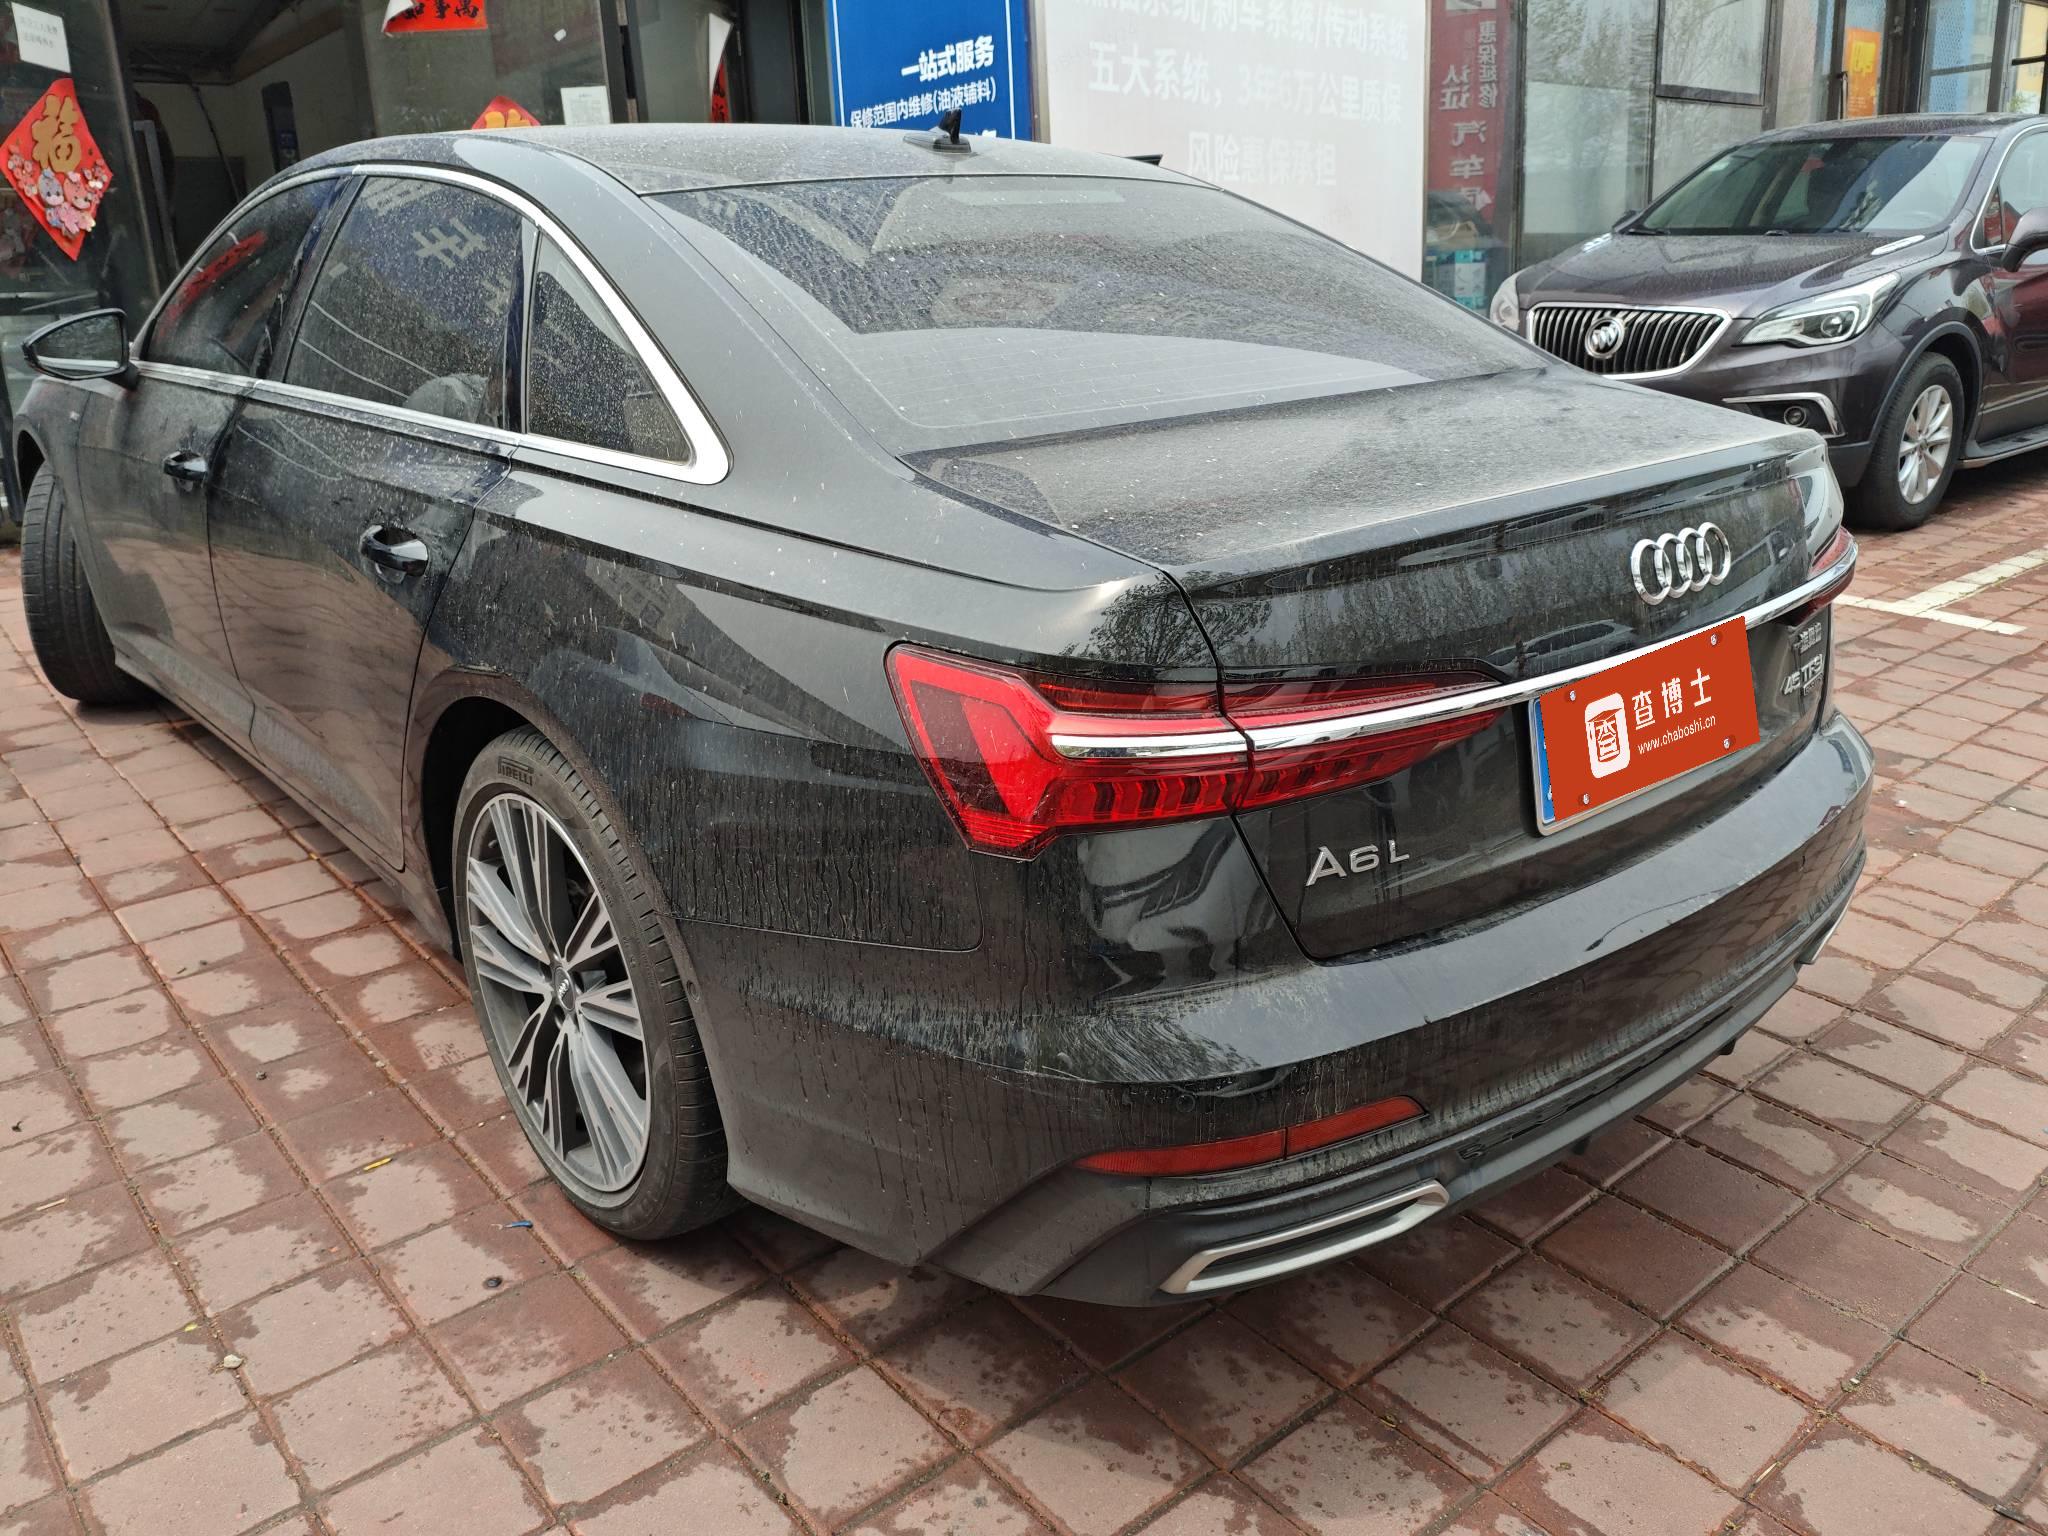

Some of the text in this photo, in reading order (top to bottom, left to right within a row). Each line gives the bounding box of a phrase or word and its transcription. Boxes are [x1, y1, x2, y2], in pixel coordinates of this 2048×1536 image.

[901, 35, 994, 82] 一站式服务
[851, 77, 996, 129] 保修范围内维修(油液辅料)
[31, 94, 82, 173] 福
[1187, 131, 1337, 187] 风险惠保承担
[499, 756, 534, 787] PIRELLI
[1305, 839, 1410, 887] A6L
